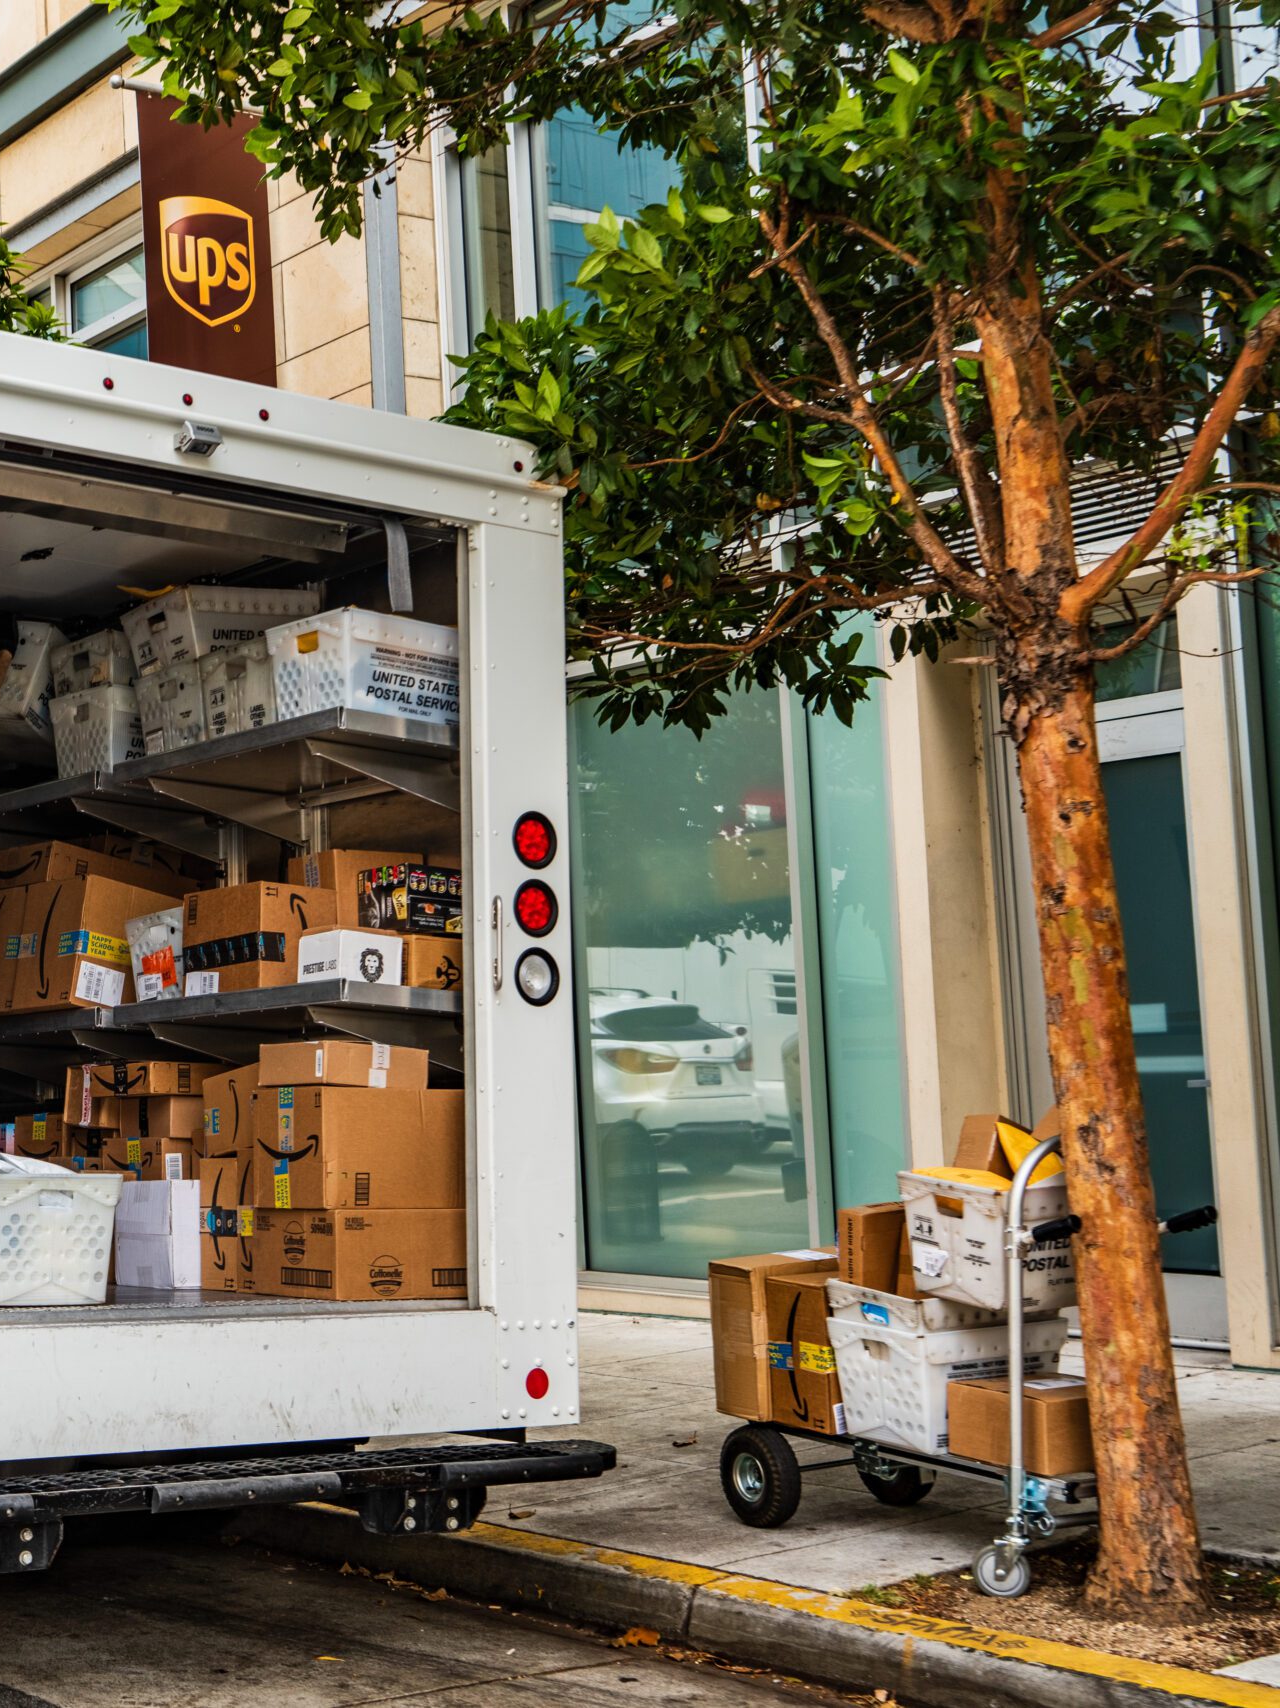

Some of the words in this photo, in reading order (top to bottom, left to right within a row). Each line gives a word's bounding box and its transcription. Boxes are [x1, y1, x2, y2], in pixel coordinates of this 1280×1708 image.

[169, 232, 250, 306] ups
[212, 628, 255, 640] UNITED
[375, 646, 401, 657] WARNING
[405, 652, 417, 660] NOT
[417, 654, 429, 662] FOR
[372, 669, 416, 688] UNITED
[366, 685, 413, 704] POSTAL
[415, 694, 460, 714] SERVIC
[250, 703, 265, 714] LABEL
[212, 711, 226, 721] LABEL
[250, 711, 266, 721] OTHER
[253, 719, 263, 727] END
[91, 934, 113, 945] HAPPY
[90, 940, 116, 952] SCHOOL
[90, 947, 107, 957] YEAR
[303, 961, 325, 975] PRESTIGE
[325, 959, 337, 972] LABS
[847, 1247, 854, 1256] OF
[872, 1613, 998, 1645] SFMTA
